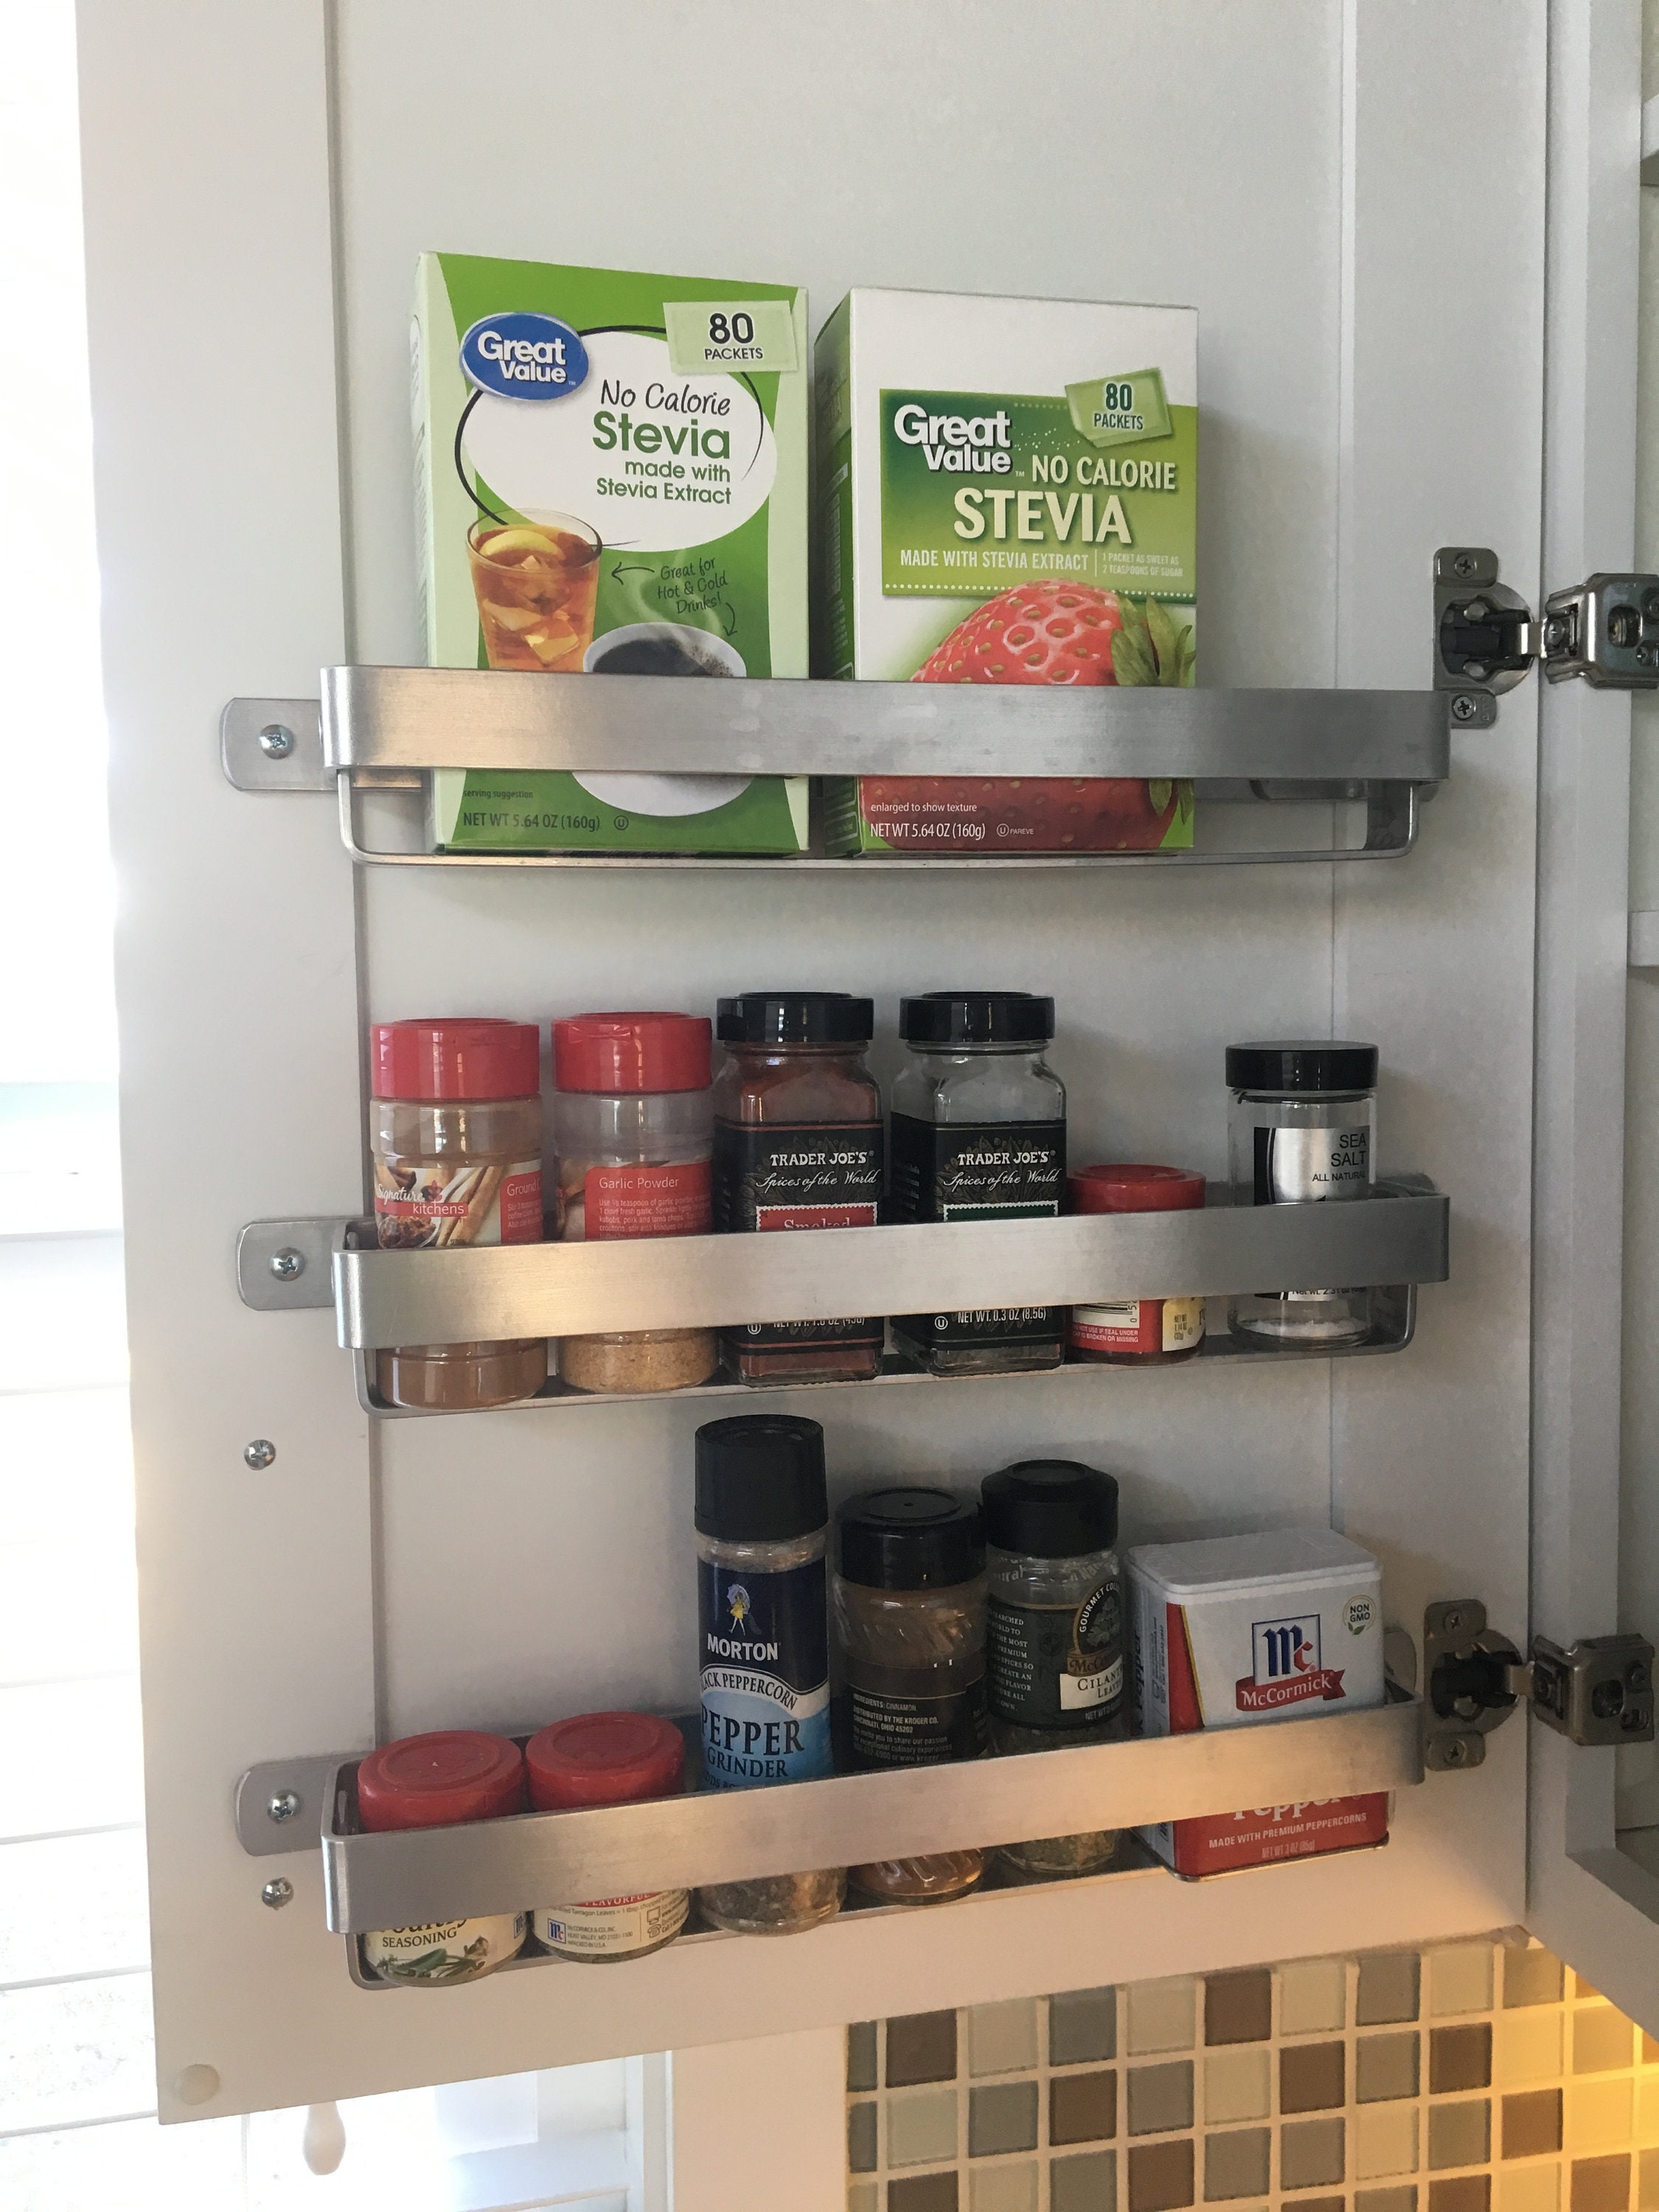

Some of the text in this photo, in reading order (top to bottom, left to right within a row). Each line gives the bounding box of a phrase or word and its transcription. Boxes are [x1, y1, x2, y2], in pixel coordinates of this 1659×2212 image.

[709, 313, 754, 344] 80
[478, 330, 566, 365] Great
[704, 347, 763, 361] PACKETS
[499, 360, 566, 383] Value
[600, 379, 731, 416] No Calorie
[1105, 383, 1133, 411] 80
[894, 404, 1011, 448] Great
[1094, 413, 1144, 431] PACKETS
[592, 411, 731, 459] Stevia
[922, 444, 1012, 473] Value
[625, 461, 731, 483] made with
[1032, 454, 1176, 490] NO CALORIE
[597, 478, 731, 504] Stevia Extract
[954, 487, 1133, 544] STEVIA
[900, 549, 1088, 571] MADE WITH STEVIA EXTRACT
[1109, 553, 1134, 563] PACKET
[1136, 554, 1145, 563] AS
[1147, 555, 1169, 565] SWEET
[1171, 557, 1179, 565] AS
[660, 557, 715, 580] Great for
[1103, 565, 1183, 577] 2 TEASPOONS OF SUGAR
[658, 570, 728, 599] Hot & Cold
[676, 591, 721, 613] Drinks!
[463, 790, 534, 800] serving suggestion
[871, 803, 978, 813] enlarged to show texture
[464, 813, 600, 832] NET WT 5.64 OZ (160g)
[871, 824, 891, 837] NET
[892, 824, 910, 837] WT
[911, 824, 934, 837] 5.64
[936, 824, 950, 837] OZ
[952, 823, 986, 841] (160g)
[1340, 1133, 1367, 1149] SEA
[770, 1151, 867, 1166] TRADER JOE'S
[957, 1151, 1050, 1166] TRADER JOE'S
[1331, 1151, 1366, 1167] SALT
[599, 1177, 679, 1189] Garlic Powder
[756, 1169, 881, 1194] Spices of the World
[944, 1168, 1062, 1192] Spices of the World
[1312, 1172, 1366, 1182] ALL NATURAL
[377, 1183, 423, 1206] Signature
[507, 1182, 536, 1196] Ground
[413, 1201, 465, 1215] kitchens
[621, 1199, 648, 1208] teaspoon
[658, 1198, 674, 1207] garlic
[623, 1216, 637, 1224] pork
[959, 1307, 1046, 1324] NET WT. 0.3 OZ (8.5G)
[1086, 1332, 1106, 1340] BROKEN
[1079, 1587, 1105, 1632] GOURMET
[1349, 1604, 1370, 1613] NON
[1349, 1612, 1371, 1622] GMO
[992, 1611, 1024, 1625] EARCHED
[1011, 1628, 1021, 1636] TO
[708, 1632, 779, 1661] MORTON
[997, 1645, 1027, 1658] PREMIUM
[1009, 1638, 1028, 1648] MOST
[1001, 1656, 1023, 1669] SPICES
[702, 1672, 799, 1711] LACK PEPPERCORN
[1006, 1680, 1032, 1691] FLAVOR
[1241, 1674, 1332, 1707] McCormick
[1012, 1692, 1026, 1701] ALL
[701, 1704, 805, 1756] PEPPER
[880, 1723, 894, 1731] OHIO
[891, 1744, 916, 1754] culinary
[917, 1744, 952, 1753] experiences
[894, 1736, 911, 1745] share
[924, 1736, 947, 1745] passion
[708, 1747, 789, 1778] GRINDER
[1234, 1797, 1341, 1821] epp
[1209, 1812, 1367, 1848] MADE WITH PREMIUM PEPPERCORNS
[1262, 1847, 1273, 1858] NET
[1275, 1846, 1284, 1857] WT
[1286, 1844, 1290, 1854] 3
[1290, 1843, 1298, 1853] OZ
[572, 1908, 595, 1916] Tarragon
[382, 1927, 457, 1948] SEASONING
